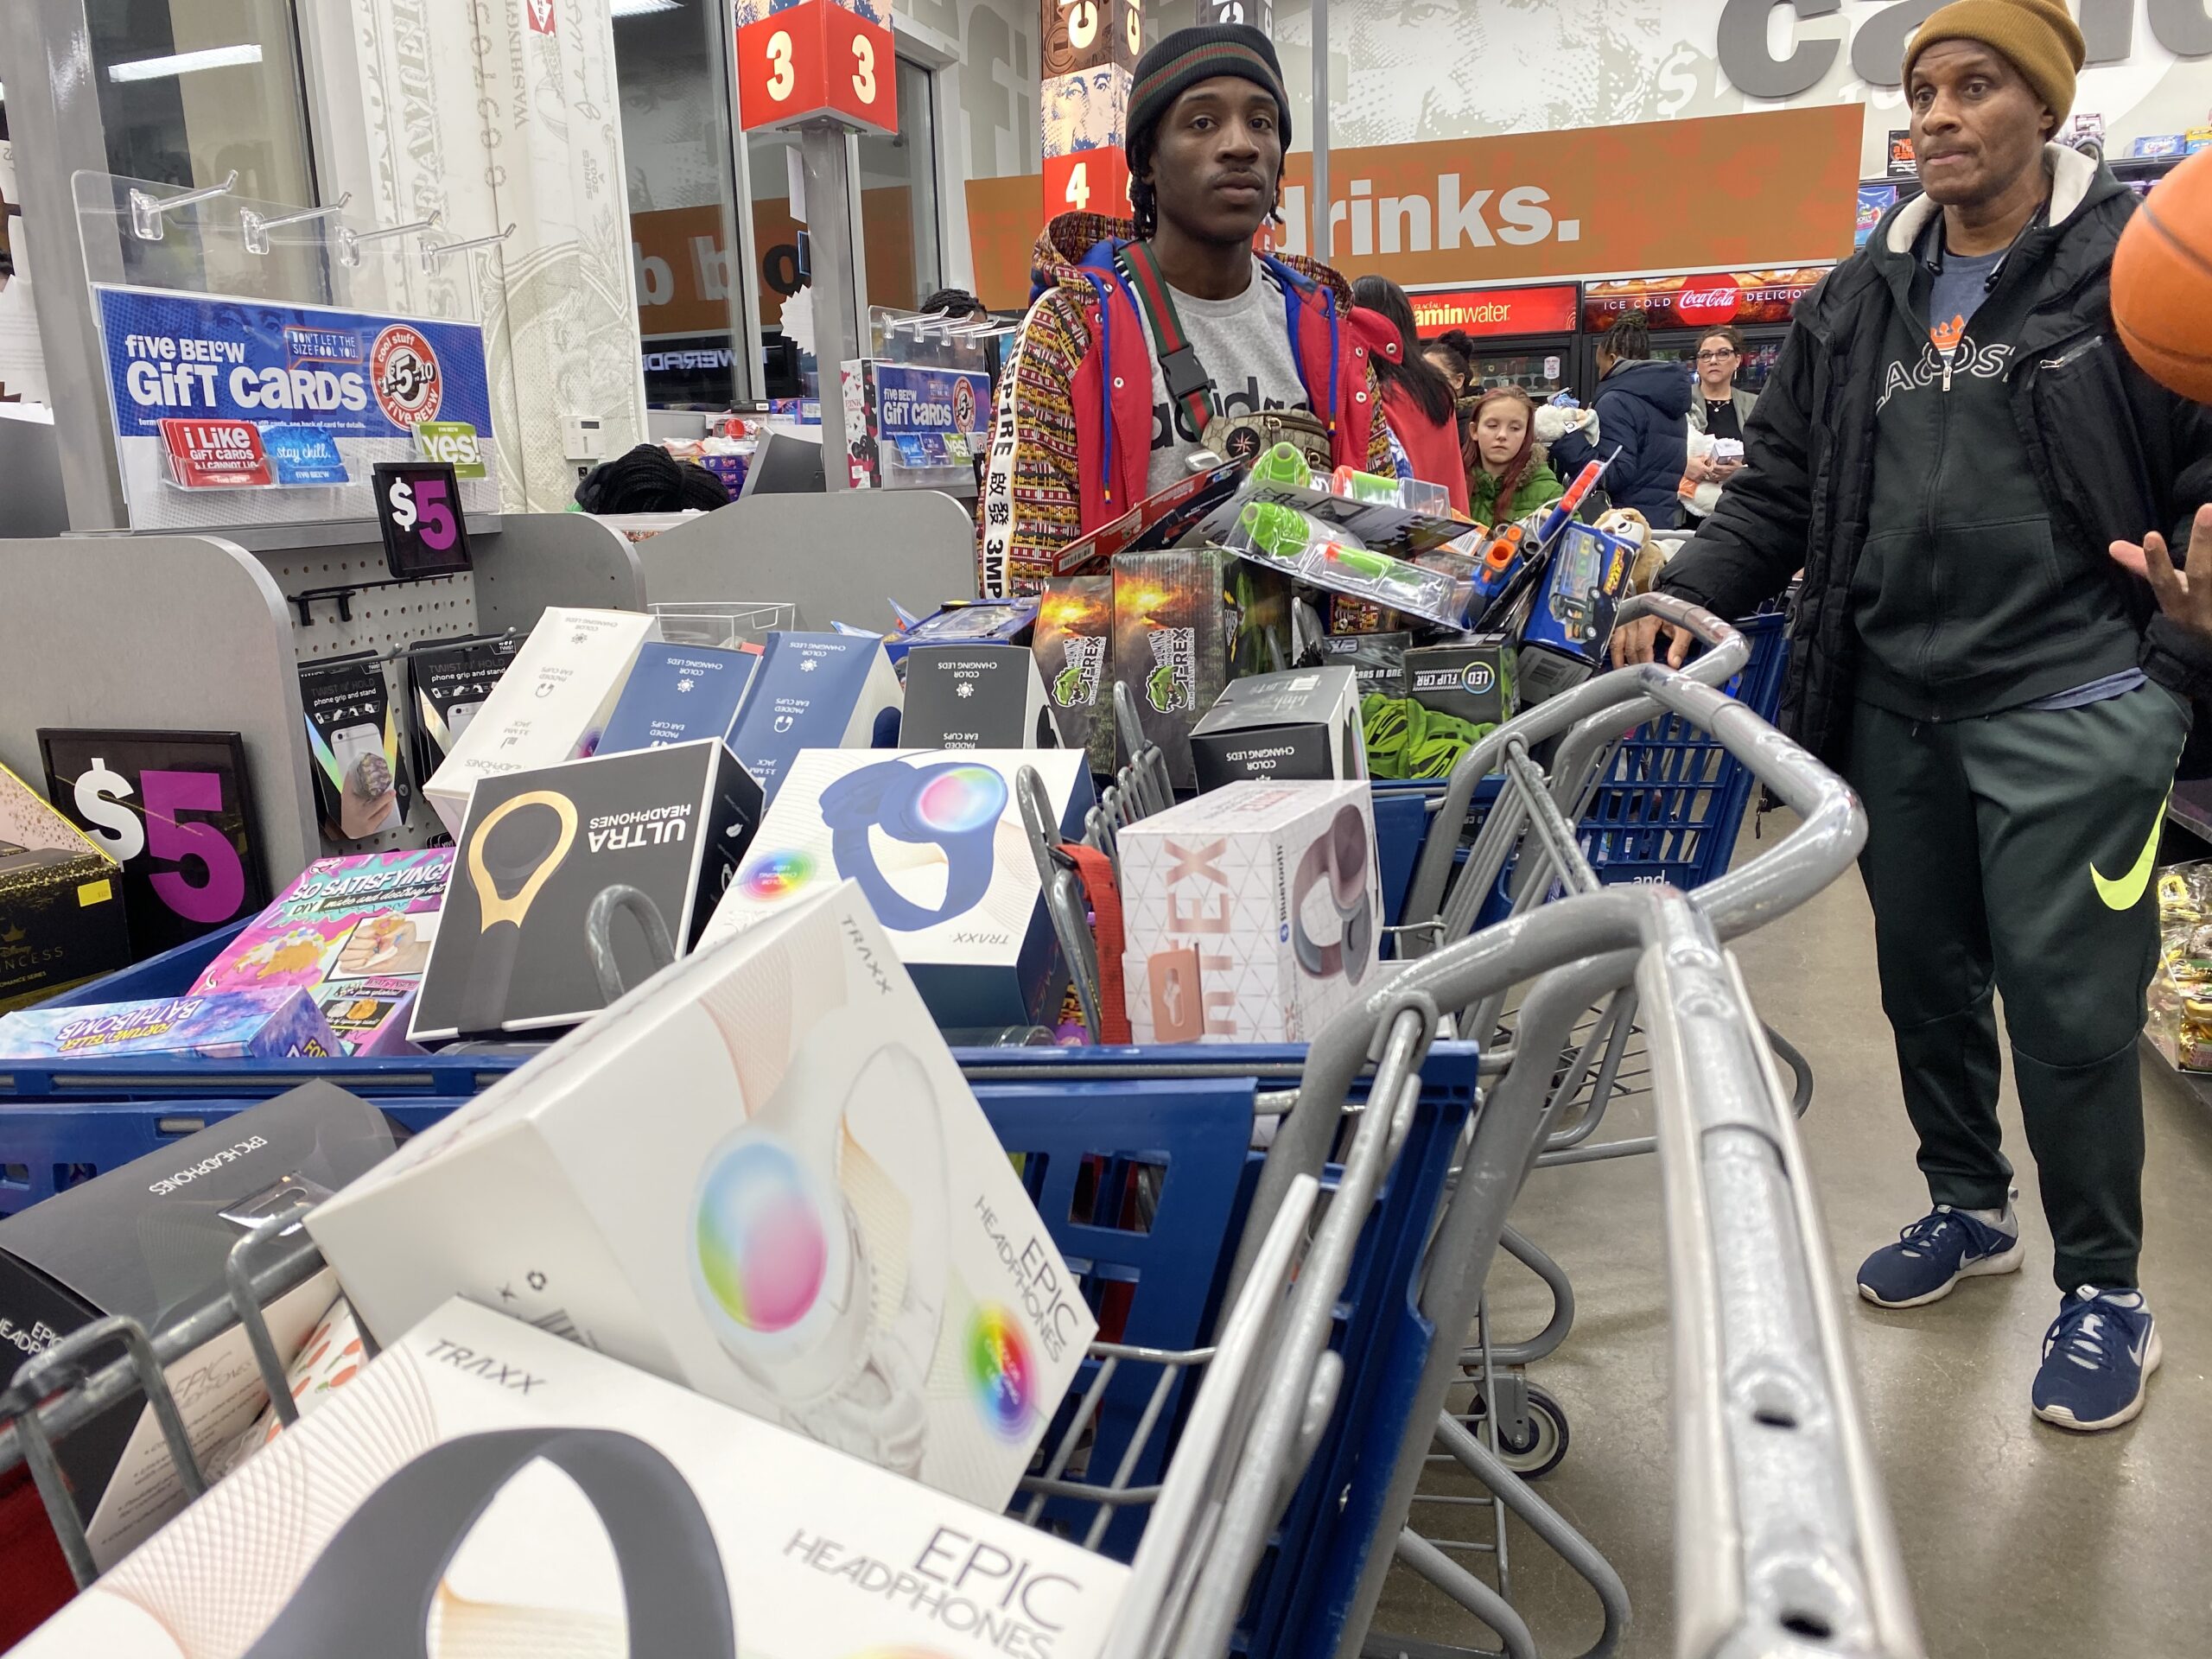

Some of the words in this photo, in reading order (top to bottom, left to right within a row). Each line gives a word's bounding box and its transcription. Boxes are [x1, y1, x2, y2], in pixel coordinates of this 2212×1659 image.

[766, 30, 795, 101] 3
[851, 35, 876, 105] 3
[582, 149, 594, 201] SERIES
[589, 158, 601, 194] 2003
[1065, 162, 1090, 210] 4
[1604, 301, 1628, 311] ICE
[1634, 297, 1670, 308] COLD
[1679, 288, 1735, 309] Coca-Cola
[125, 334, 176, 359] five
[321, 334, 337, 346] LET
[340, 335, 355, 346] THE
[378, 338, 392, 362] cool
[393, 332, 416, 346] stuff
[293, 343, 313, 355] SIZE
[315, 345, 338, 357] FOOL
[884, 388, 898, 402] five
[276, 445, 300, 463] stay
[390, 477, 456, 550] $5
[809, 643, 847, 652] CHANGING
[1147, 630, 1166, 667] WALKING
[1173, 627, 1189, 684] T-REX
[478, 658, 505, 669] HOLD
[666, 657, 684, 666] LEDS
[685, 658, 723, 671] CHANGING
[1079, 636, 1101, 683] T-REX
[431, 671, 455, 683] phone
[456, 670, 471, 681] grip
[472, 669, 486, 678] and
[486, 666, 506, 677] stand
[679, 667, 704, 677] COLOR
[1376, 668, 1384, 678] IN
[1387, 668, 1403, 678] ONE
[1416, 674, 1434, 687] CAR
[1438, 674, 1458, 686] FLIP
[1468, 671, 1489, 685] LED
[314, 696, 334, 708] phone
[334, 693, 346, 705] grip
[347, 690, 359, 701] and
[359, 688, 377, 697] stand
[774, 696, 793, 706] CUPS
[794, 698, 810, 707] EAR
[774, 705, 805, 714] PADDED
[649, 729, 679, 739] PADDED
[651, 720, 671, 730] CUPS
[671, 721, 685, 731] EAR
[1226, 751, 1247, 762] LEDS
[1248, 746, 1295, 760] CHANGING
[757, 759, 777, 767] JACK
[1246, 760, 1277, 771] COLOR
[588, 804, 692, 830] HEADPHONES
[73, 757, 245, 923] $5
[588, 818, 686, 854] ULTRA
[321, 862, 452, 898] SATISFYING!
[289, 882, 323, 902] SO
[293, 901, 318, 915] DIY
[323, 897, 355, 908] make
[356, 893, 380, 904] and
[132, 998, 204, 1031] BATH
[55, 1012, 137, 1040] BOMB
[234, 1135, 268, 1154] EPIC
[149, 1148, 242, 1196] HEADPHONES
[974, 1194, 1063, 1364] HEADPHONES
[1020, 1236, 1078, 1346] EPIC
[914, 1523, 1083, 1632] EPIC
[783, 1528, 1054, 1659] HEADPHONES
